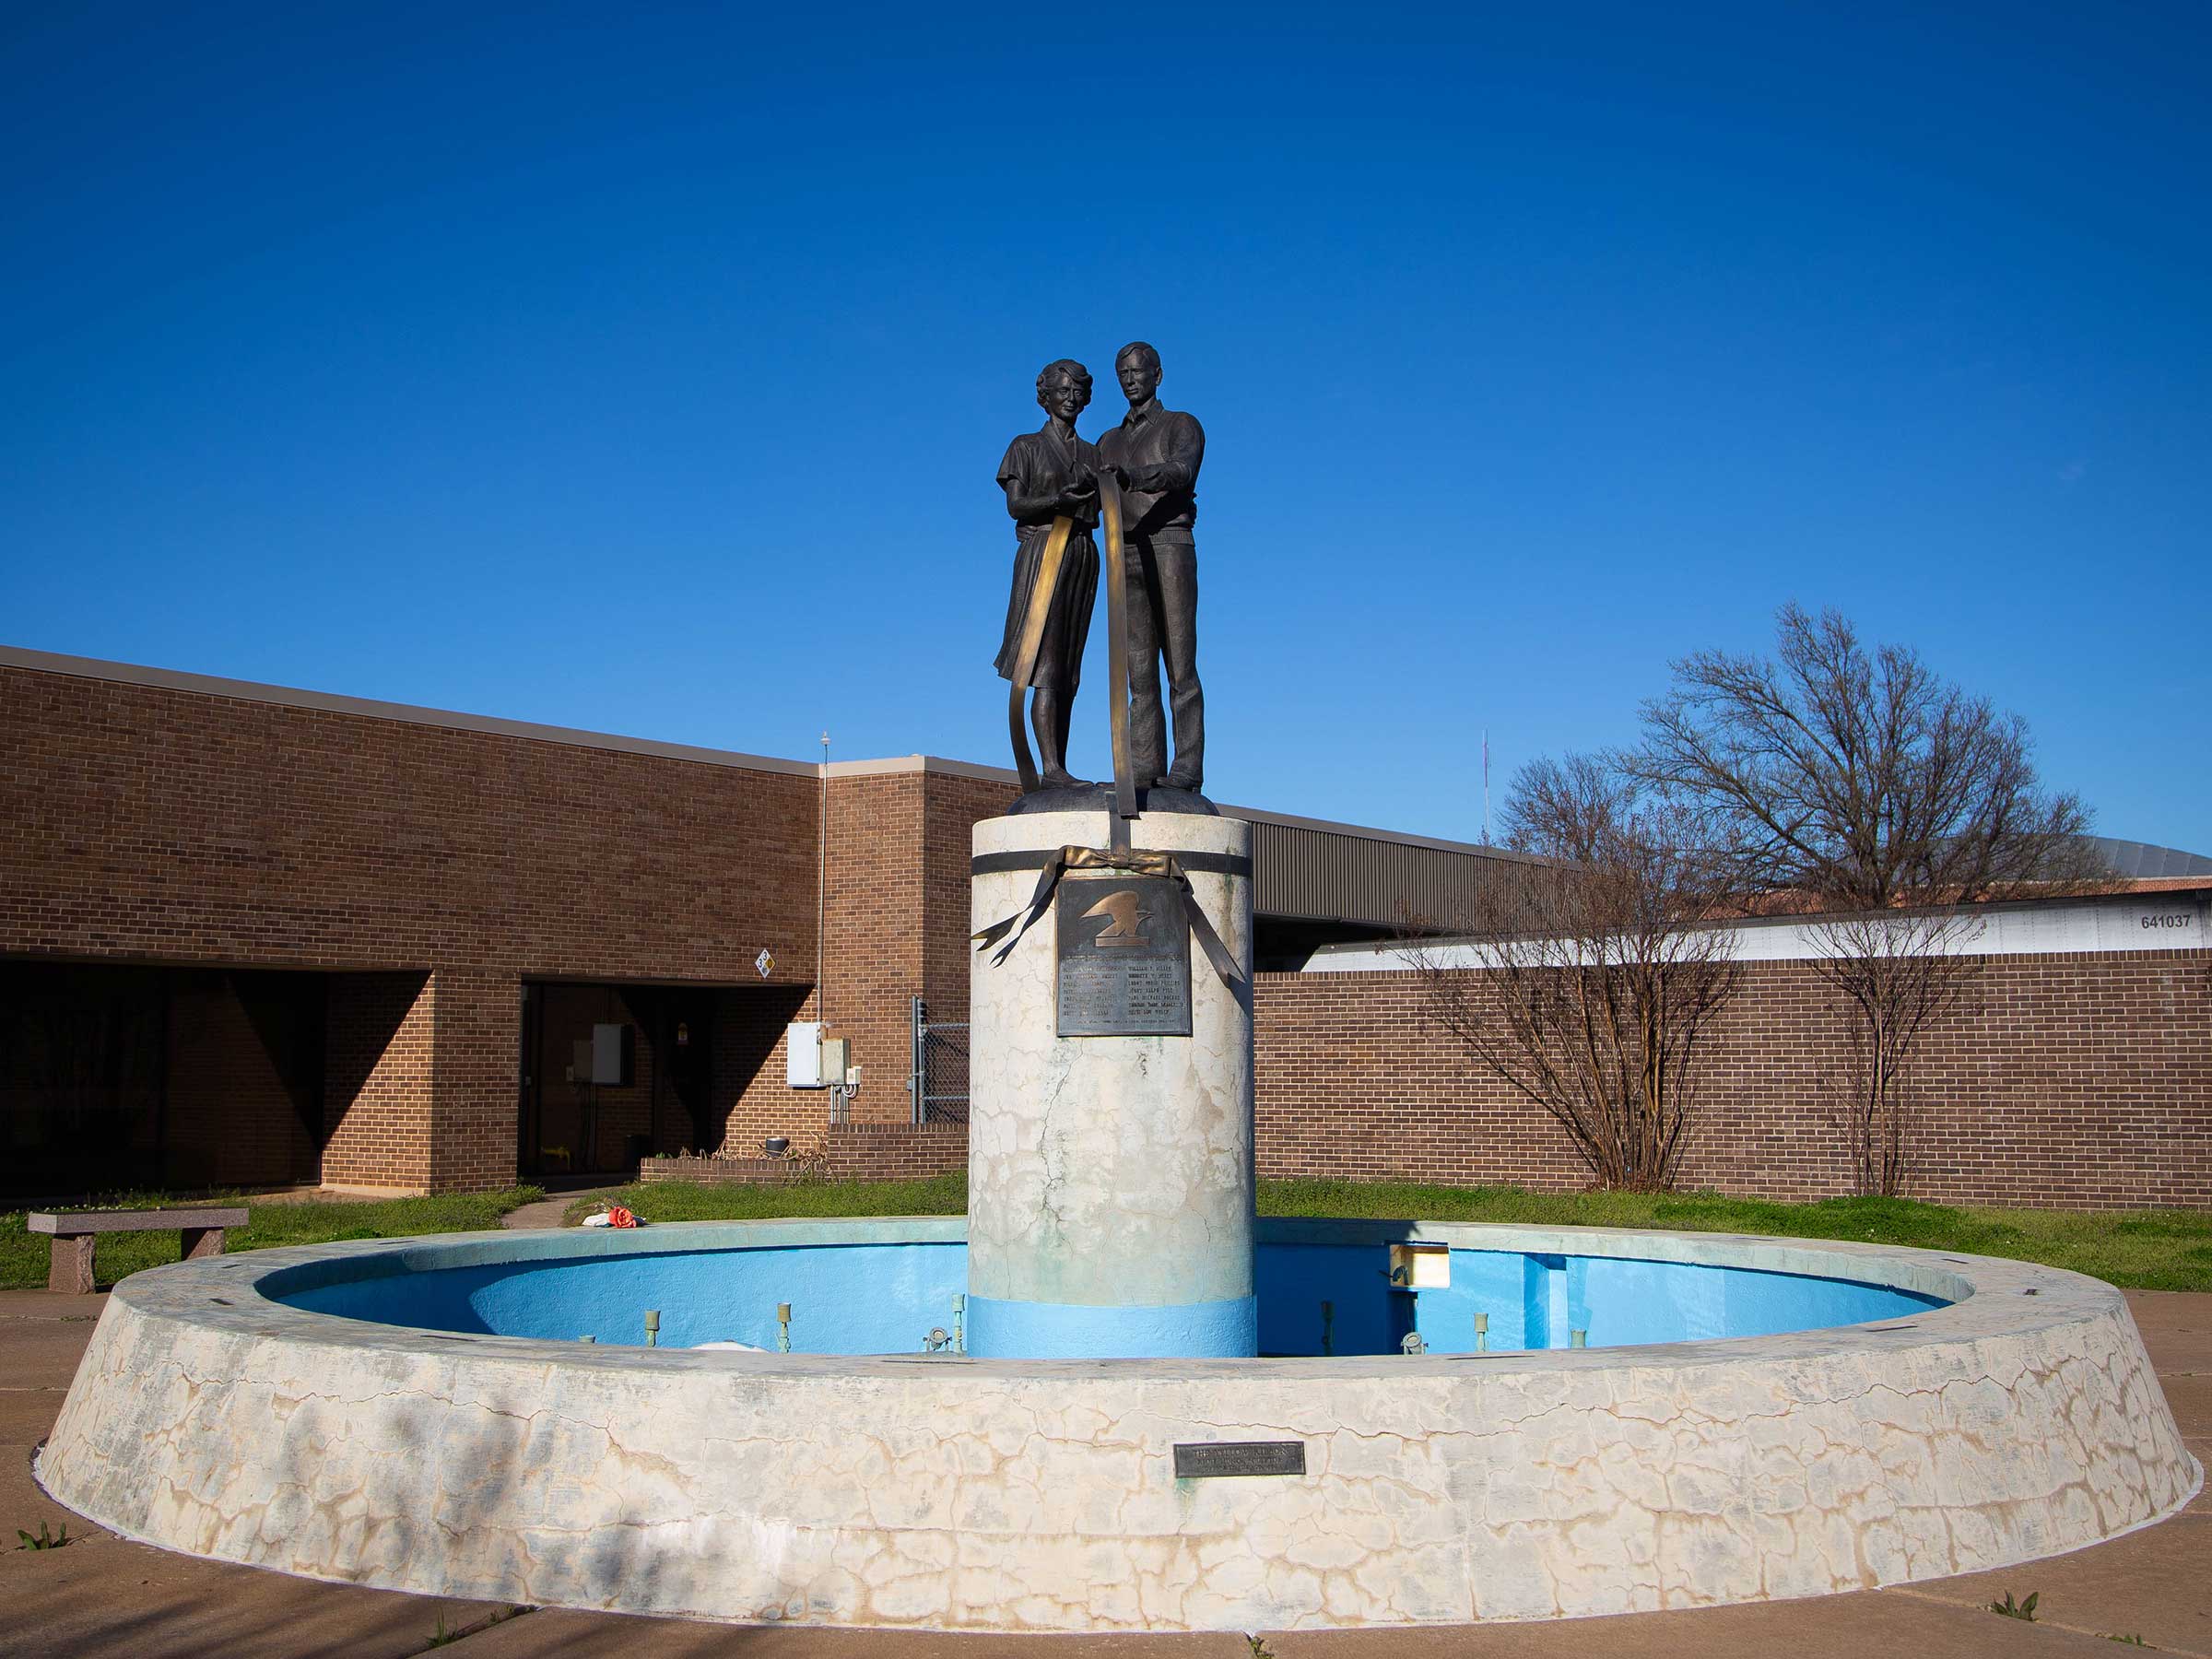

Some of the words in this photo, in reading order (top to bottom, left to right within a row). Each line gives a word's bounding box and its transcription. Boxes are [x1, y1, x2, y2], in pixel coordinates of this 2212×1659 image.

[2141, 914, 2191, 929] 641037
[763, 951, 768, 961] 3
[758, 959, 763, 969] 3
